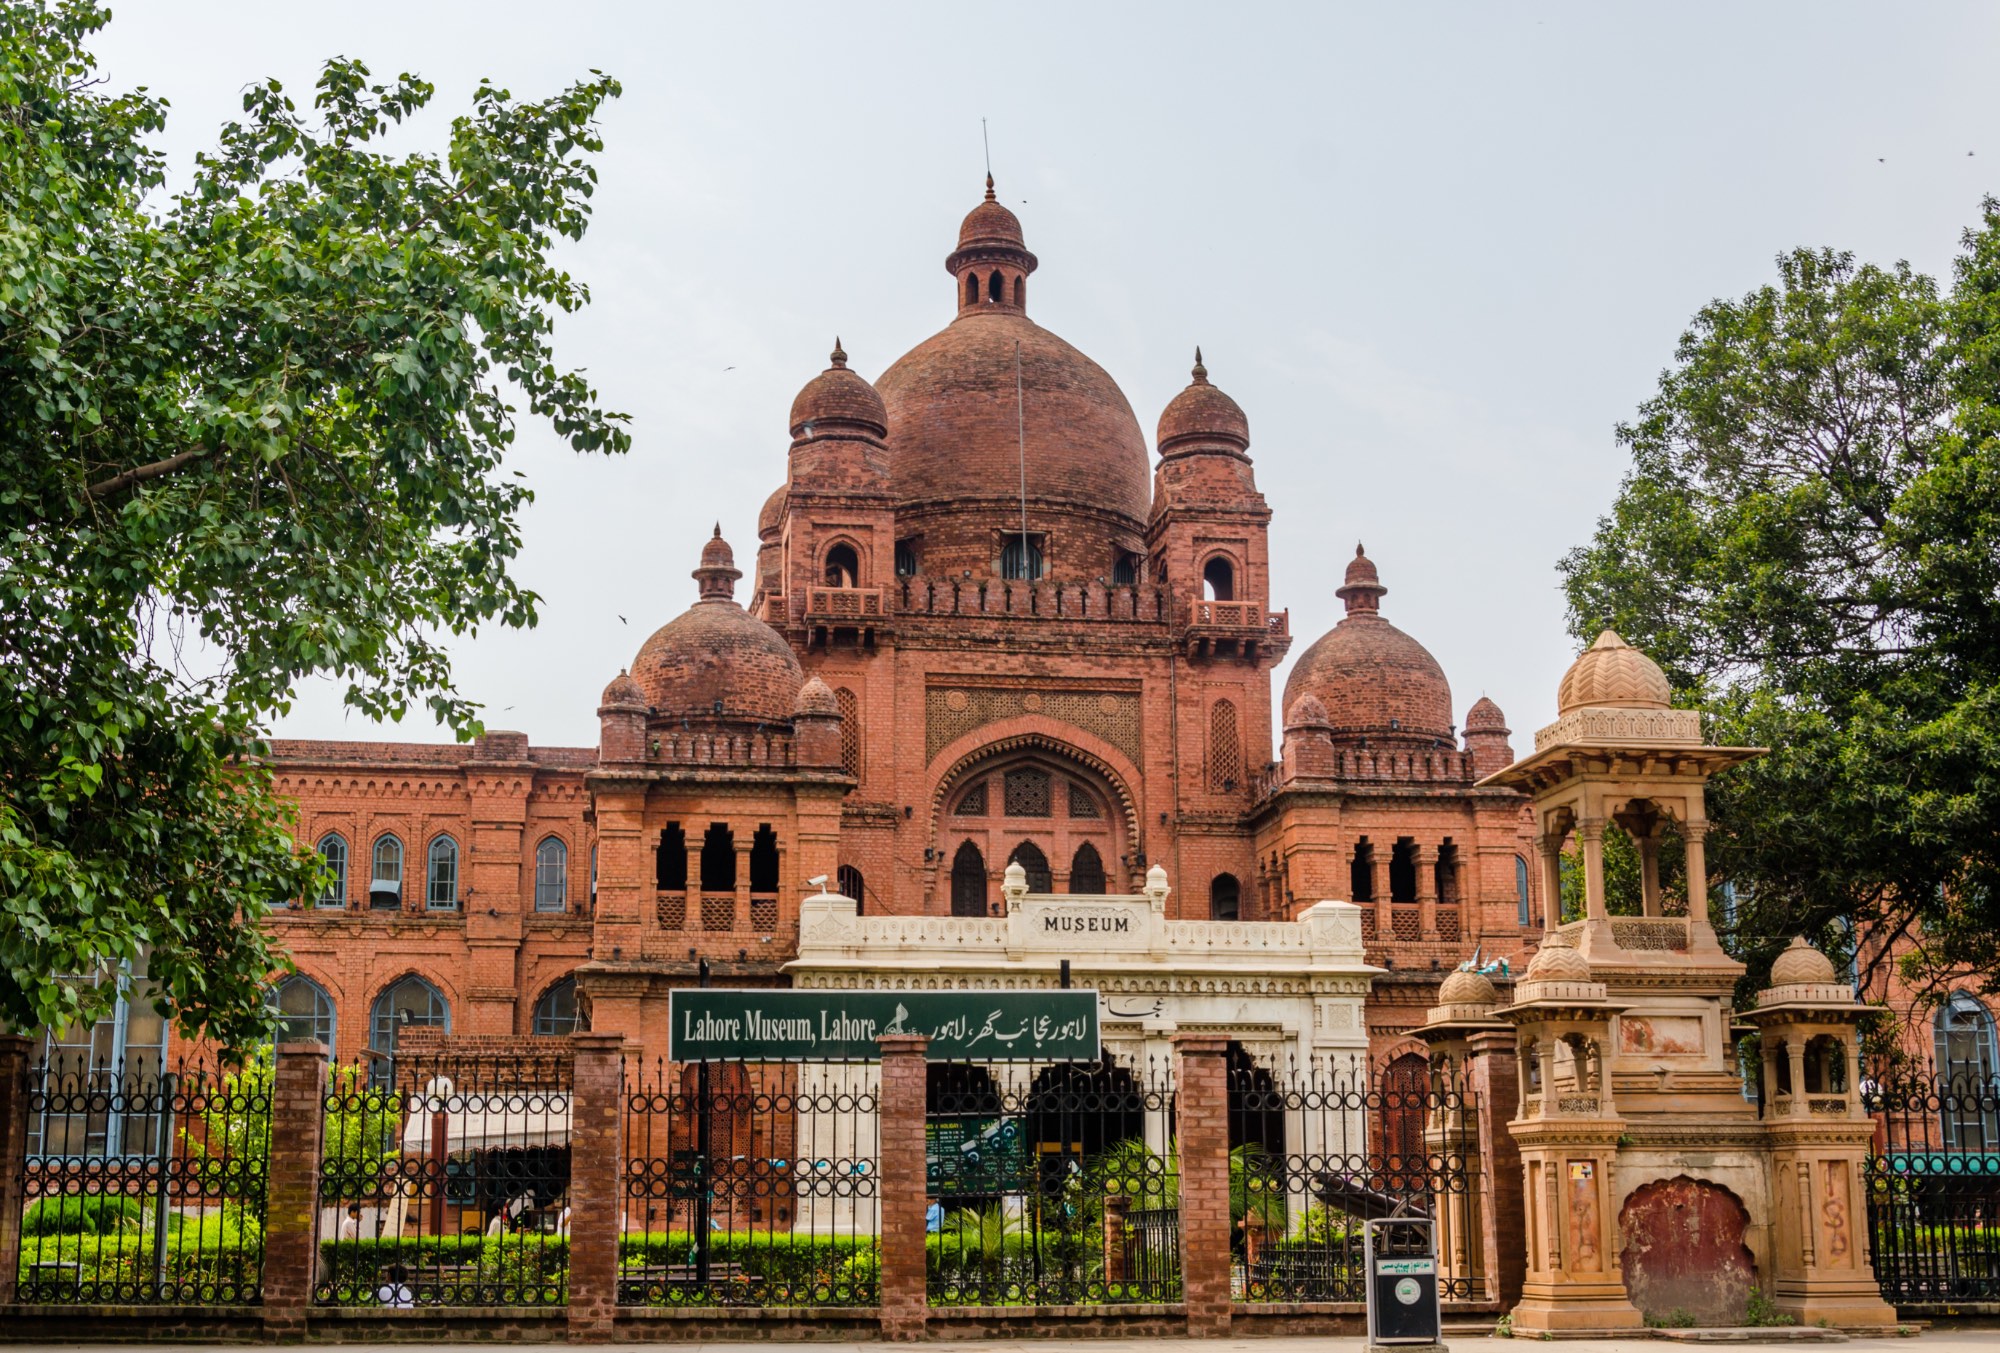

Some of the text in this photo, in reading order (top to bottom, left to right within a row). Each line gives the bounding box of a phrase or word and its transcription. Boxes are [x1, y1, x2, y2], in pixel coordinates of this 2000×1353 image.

[1044, 916, 1129, 933] MUSEUM
[684, 1010, 740, 1042] Lahore
[744, 1009, 816, 1048] Museum,
[820, 1010, 876, 1042] Lahore
[1047, 1014, 1087, 1041] لاہور
